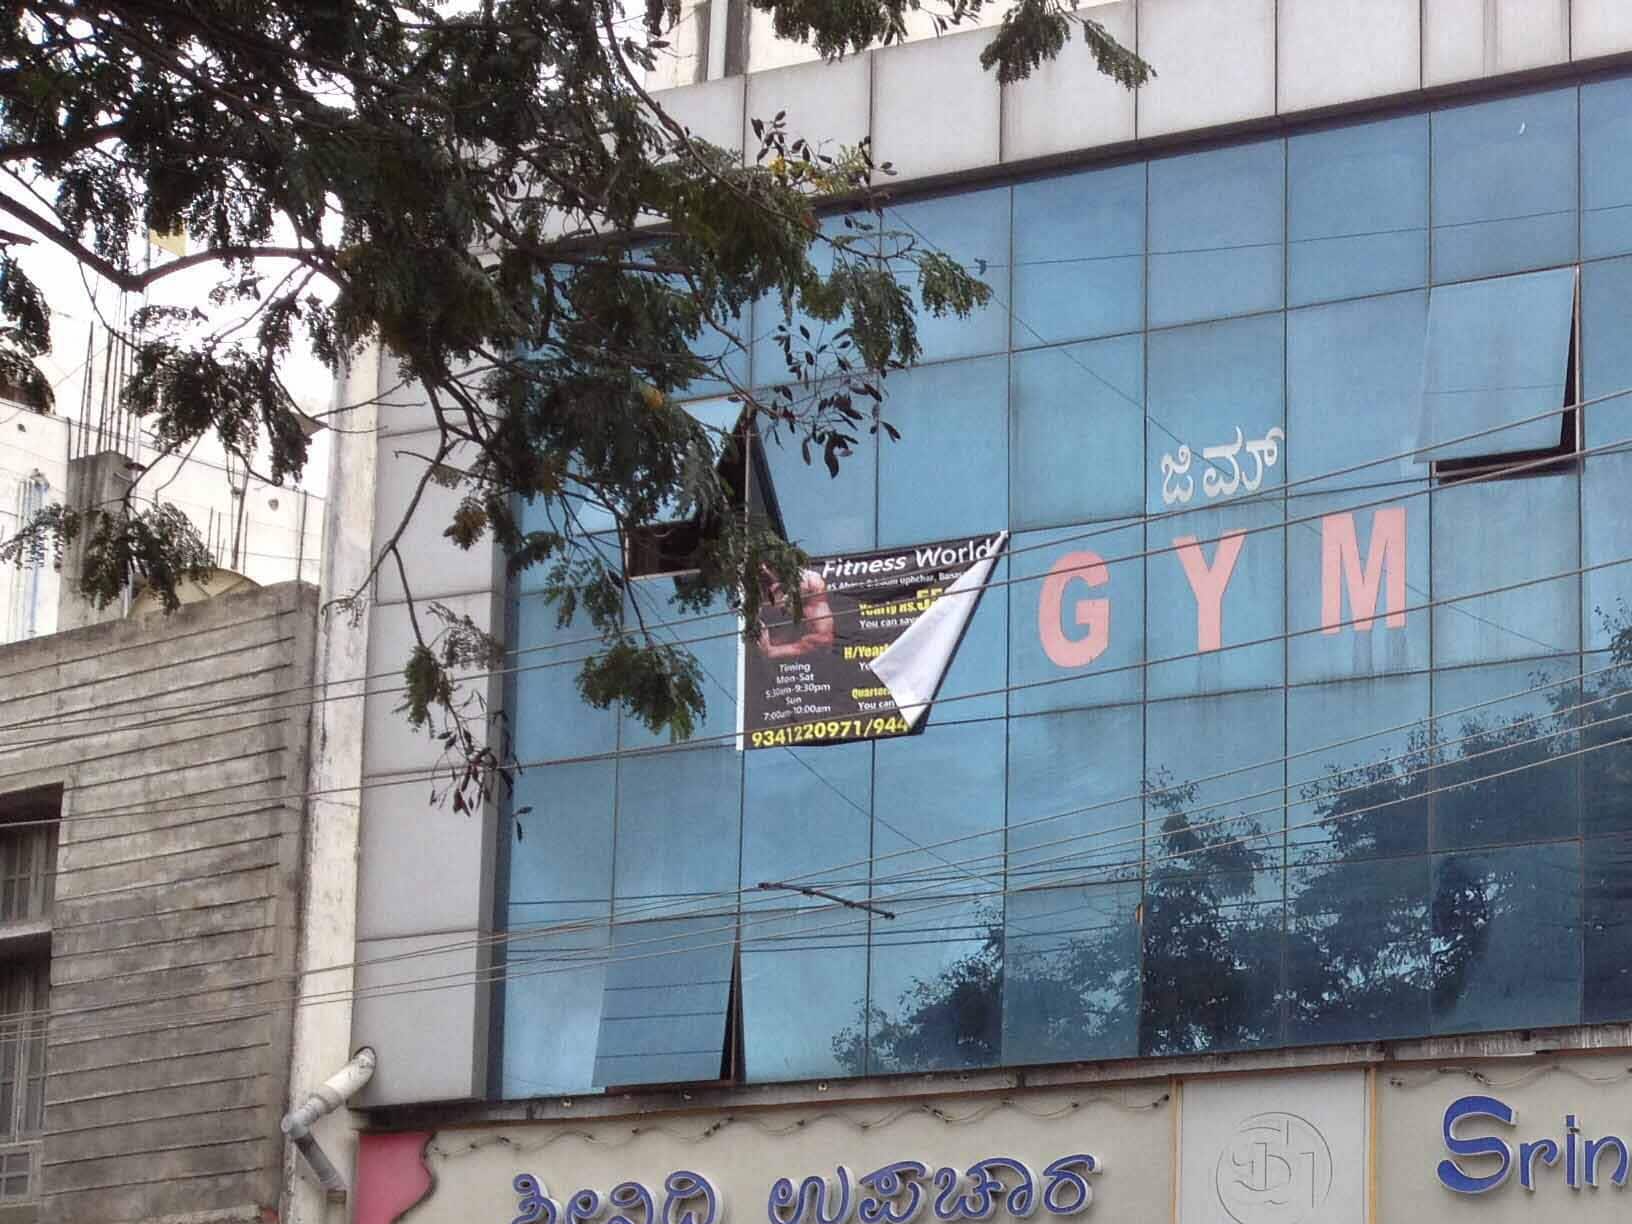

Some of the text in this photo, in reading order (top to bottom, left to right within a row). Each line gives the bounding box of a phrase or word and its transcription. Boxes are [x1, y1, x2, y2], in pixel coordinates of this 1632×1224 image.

[822, 538, 992, 579] Fitness World
[1038, 507, 1408, 668] GYM
[859, 618, 879, 629] You
[881, 616, 897, 627] can
[779, 662, 811, 673] Timing
[776, 673, 814, 685] Mon-Sat
[785, 696, 802, 705] Sun
[858, 699, 897, 712] You can
